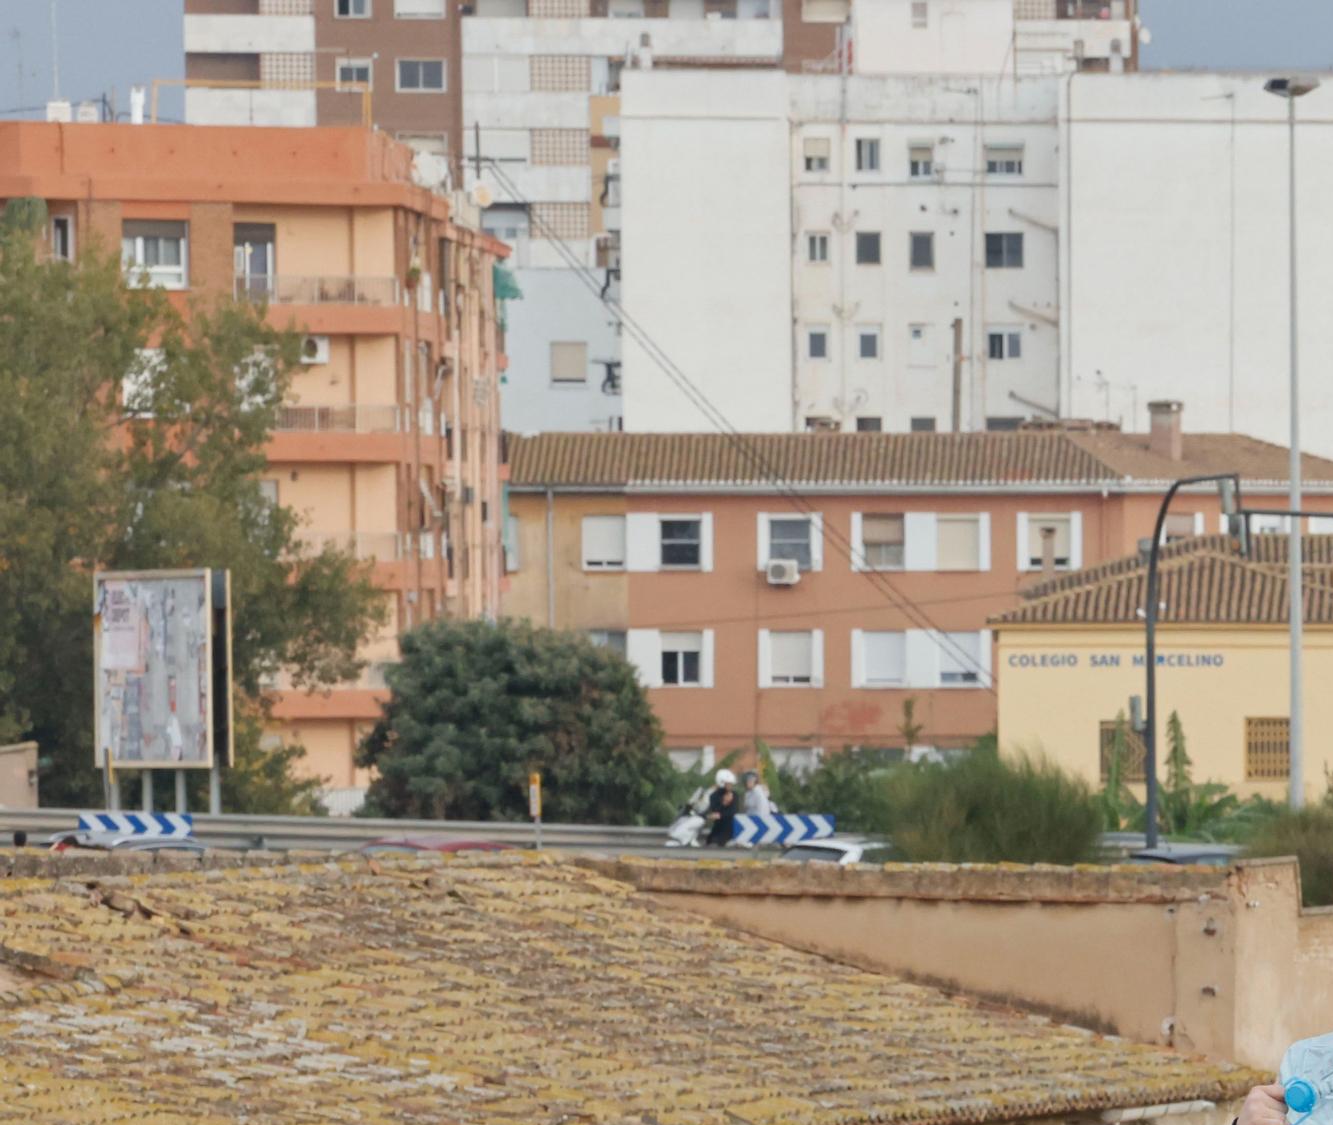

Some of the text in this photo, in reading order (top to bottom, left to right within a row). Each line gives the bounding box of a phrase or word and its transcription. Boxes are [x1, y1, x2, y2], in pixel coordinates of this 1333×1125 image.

[1008, 654, 1224, 667] COLEGIO SAN MRCELINO
